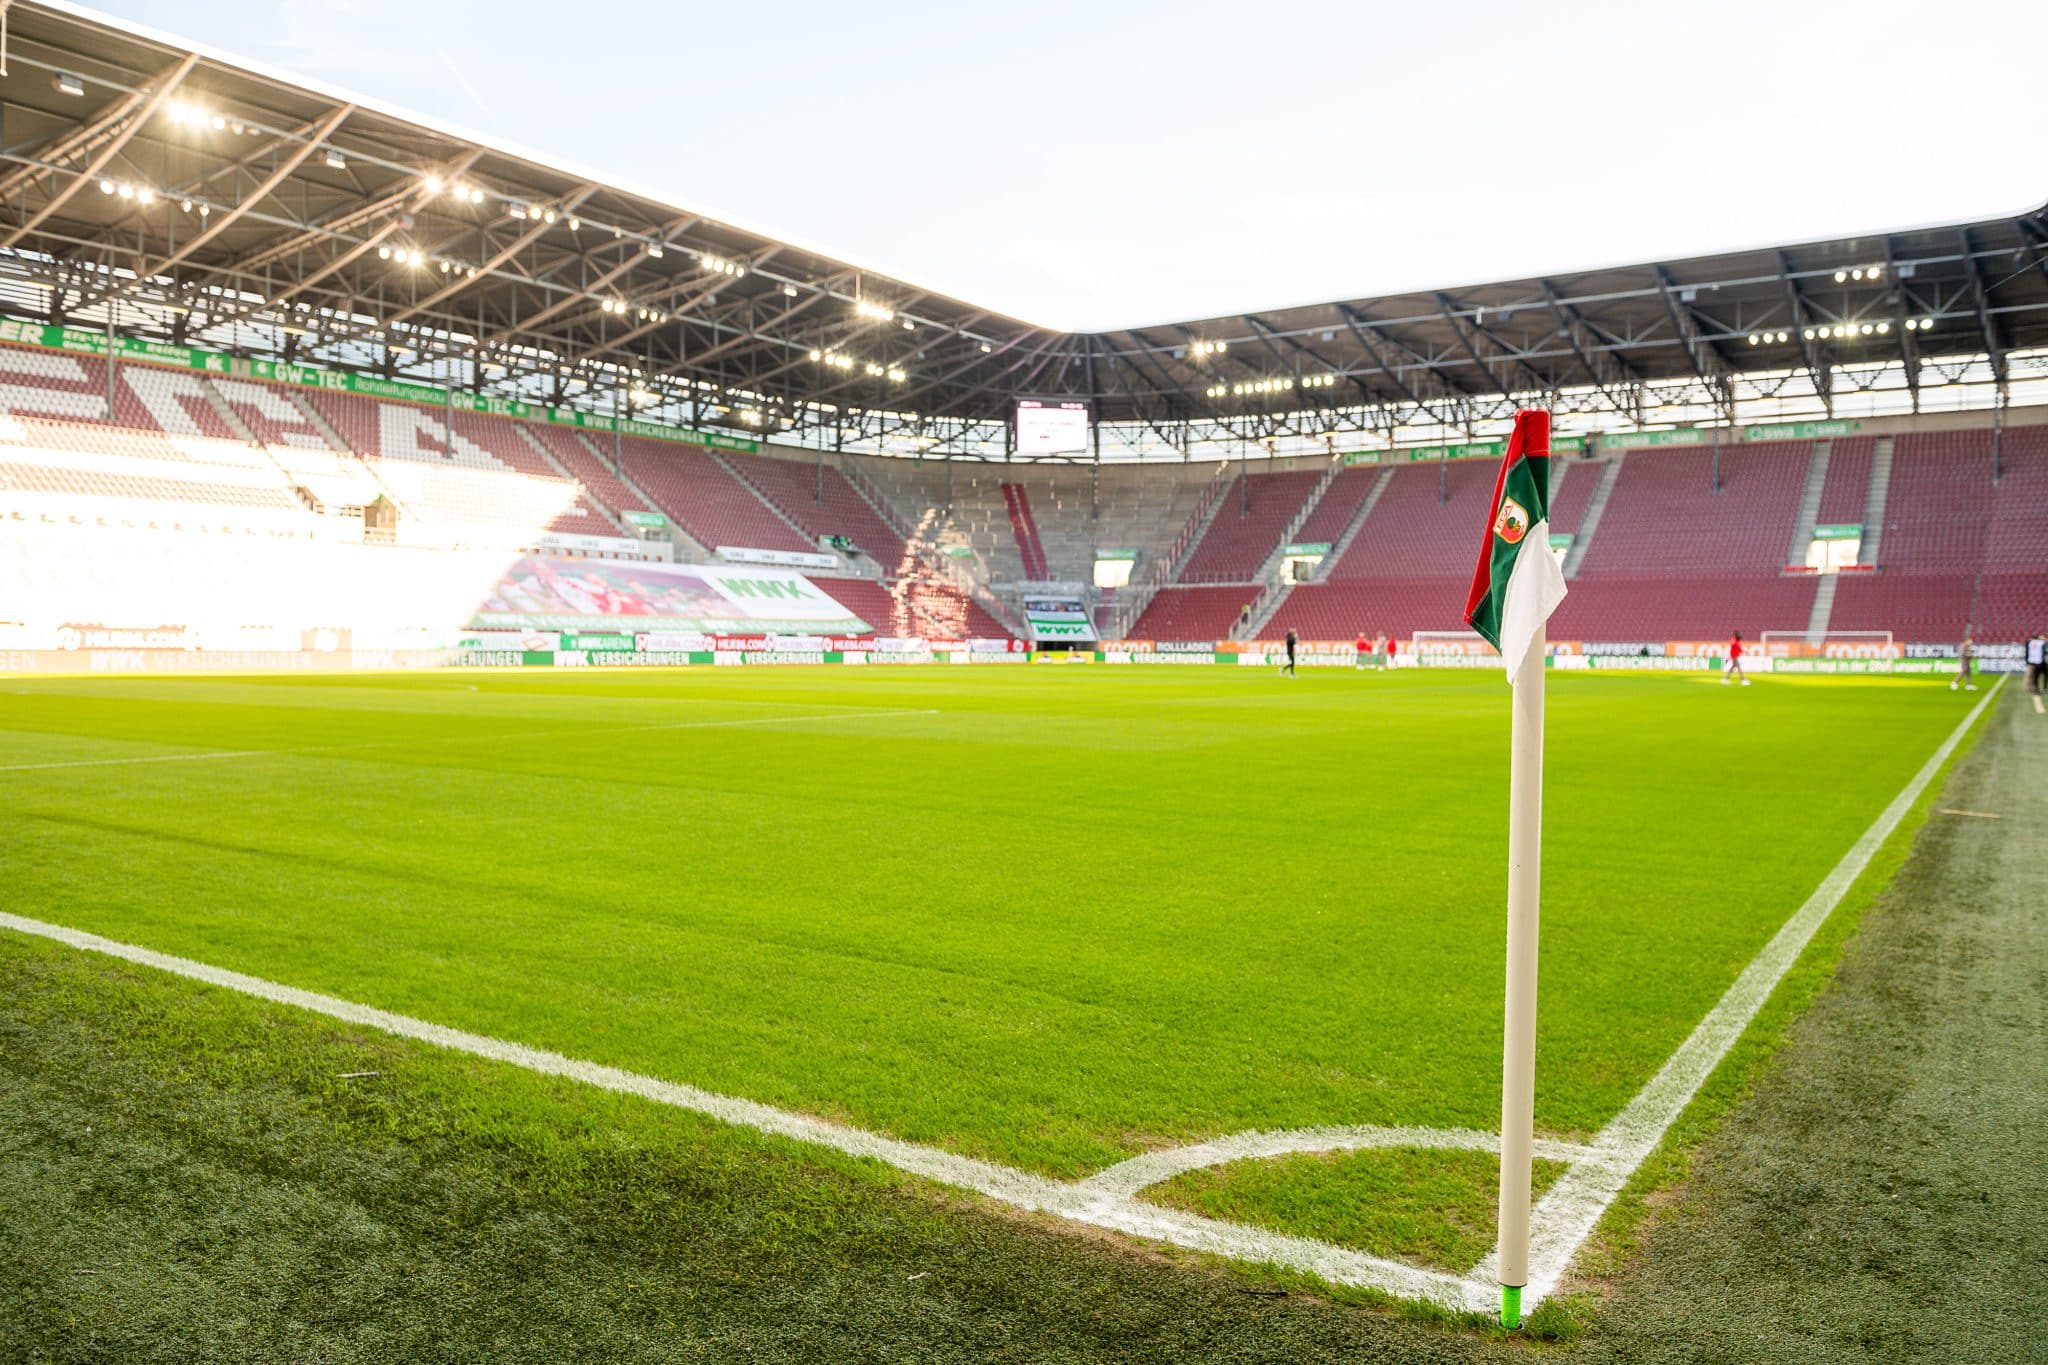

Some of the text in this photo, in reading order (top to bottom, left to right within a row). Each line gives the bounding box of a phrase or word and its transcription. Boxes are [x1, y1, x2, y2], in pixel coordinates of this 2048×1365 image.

[275, 364, 347, 390] GW-TEC
[452, 394, 513, 415] GW-TEC
[719, 577, 816, 600] WWK
[1037, 626, 1085, 635] WWK
[593, 651, 690, 665] VERSICHERUNGEN
[1594, 656, 1710, 670] VERSICHERUNGEN
